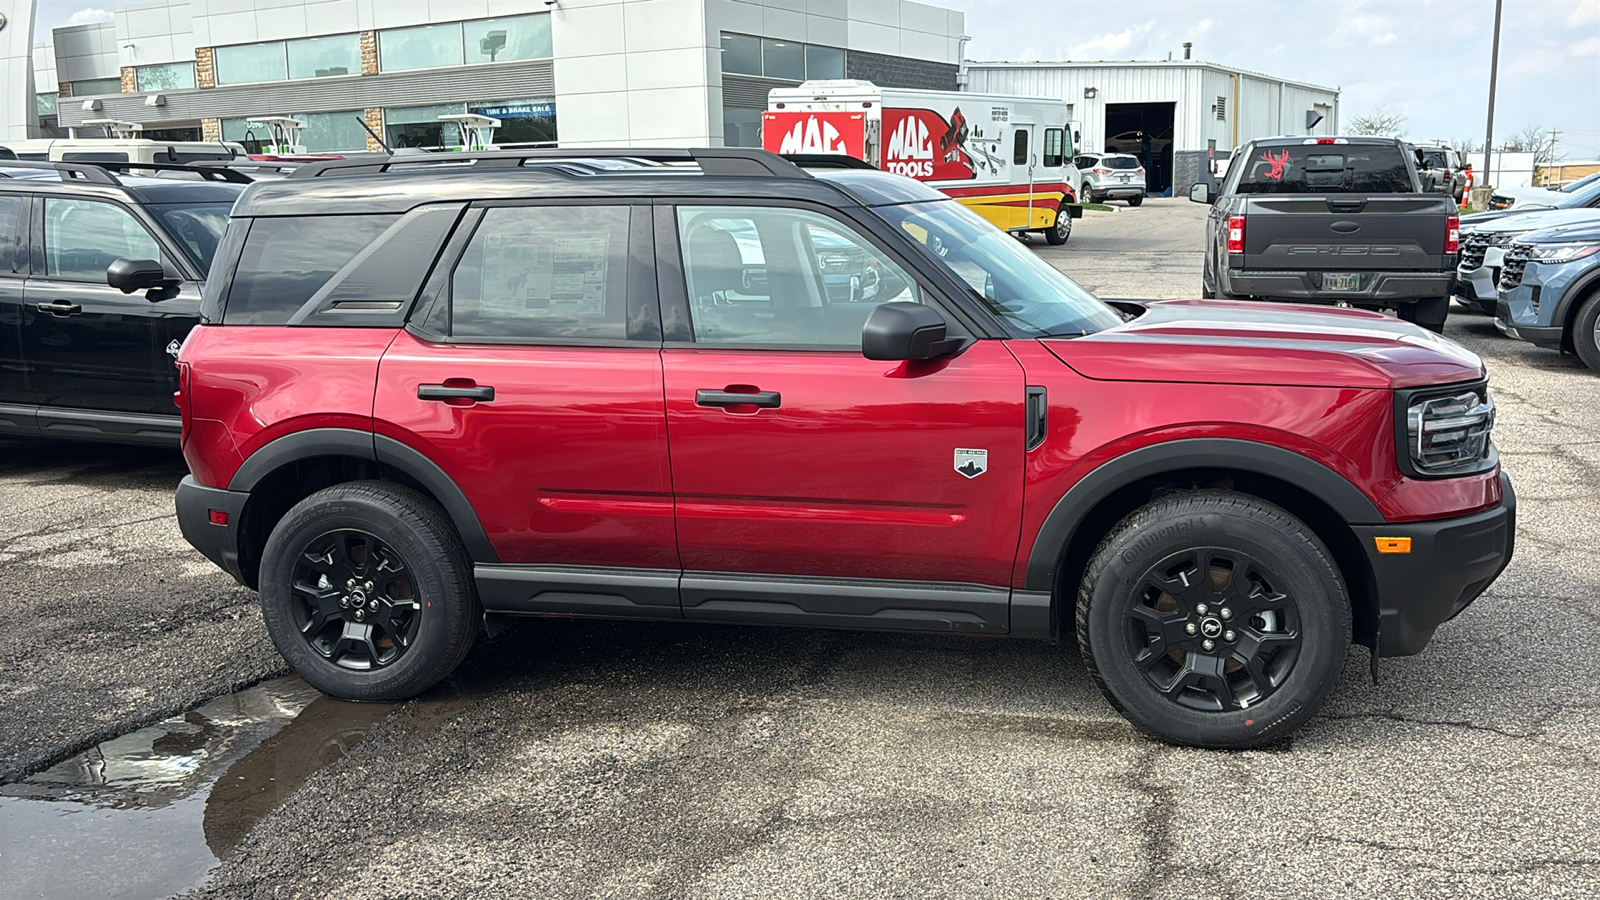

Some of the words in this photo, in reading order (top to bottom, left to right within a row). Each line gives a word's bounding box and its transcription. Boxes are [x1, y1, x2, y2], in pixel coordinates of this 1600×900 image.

[508, 106, 531, 114] BRAKE
[779, 117, 848, 156] MAC
[887, 116, 934, 160] MAC
[887, 161, 934, 177] TOOLS
[1287, 246, 1400, 256] F-150
[1121, 518, 1195, 565] Continental
